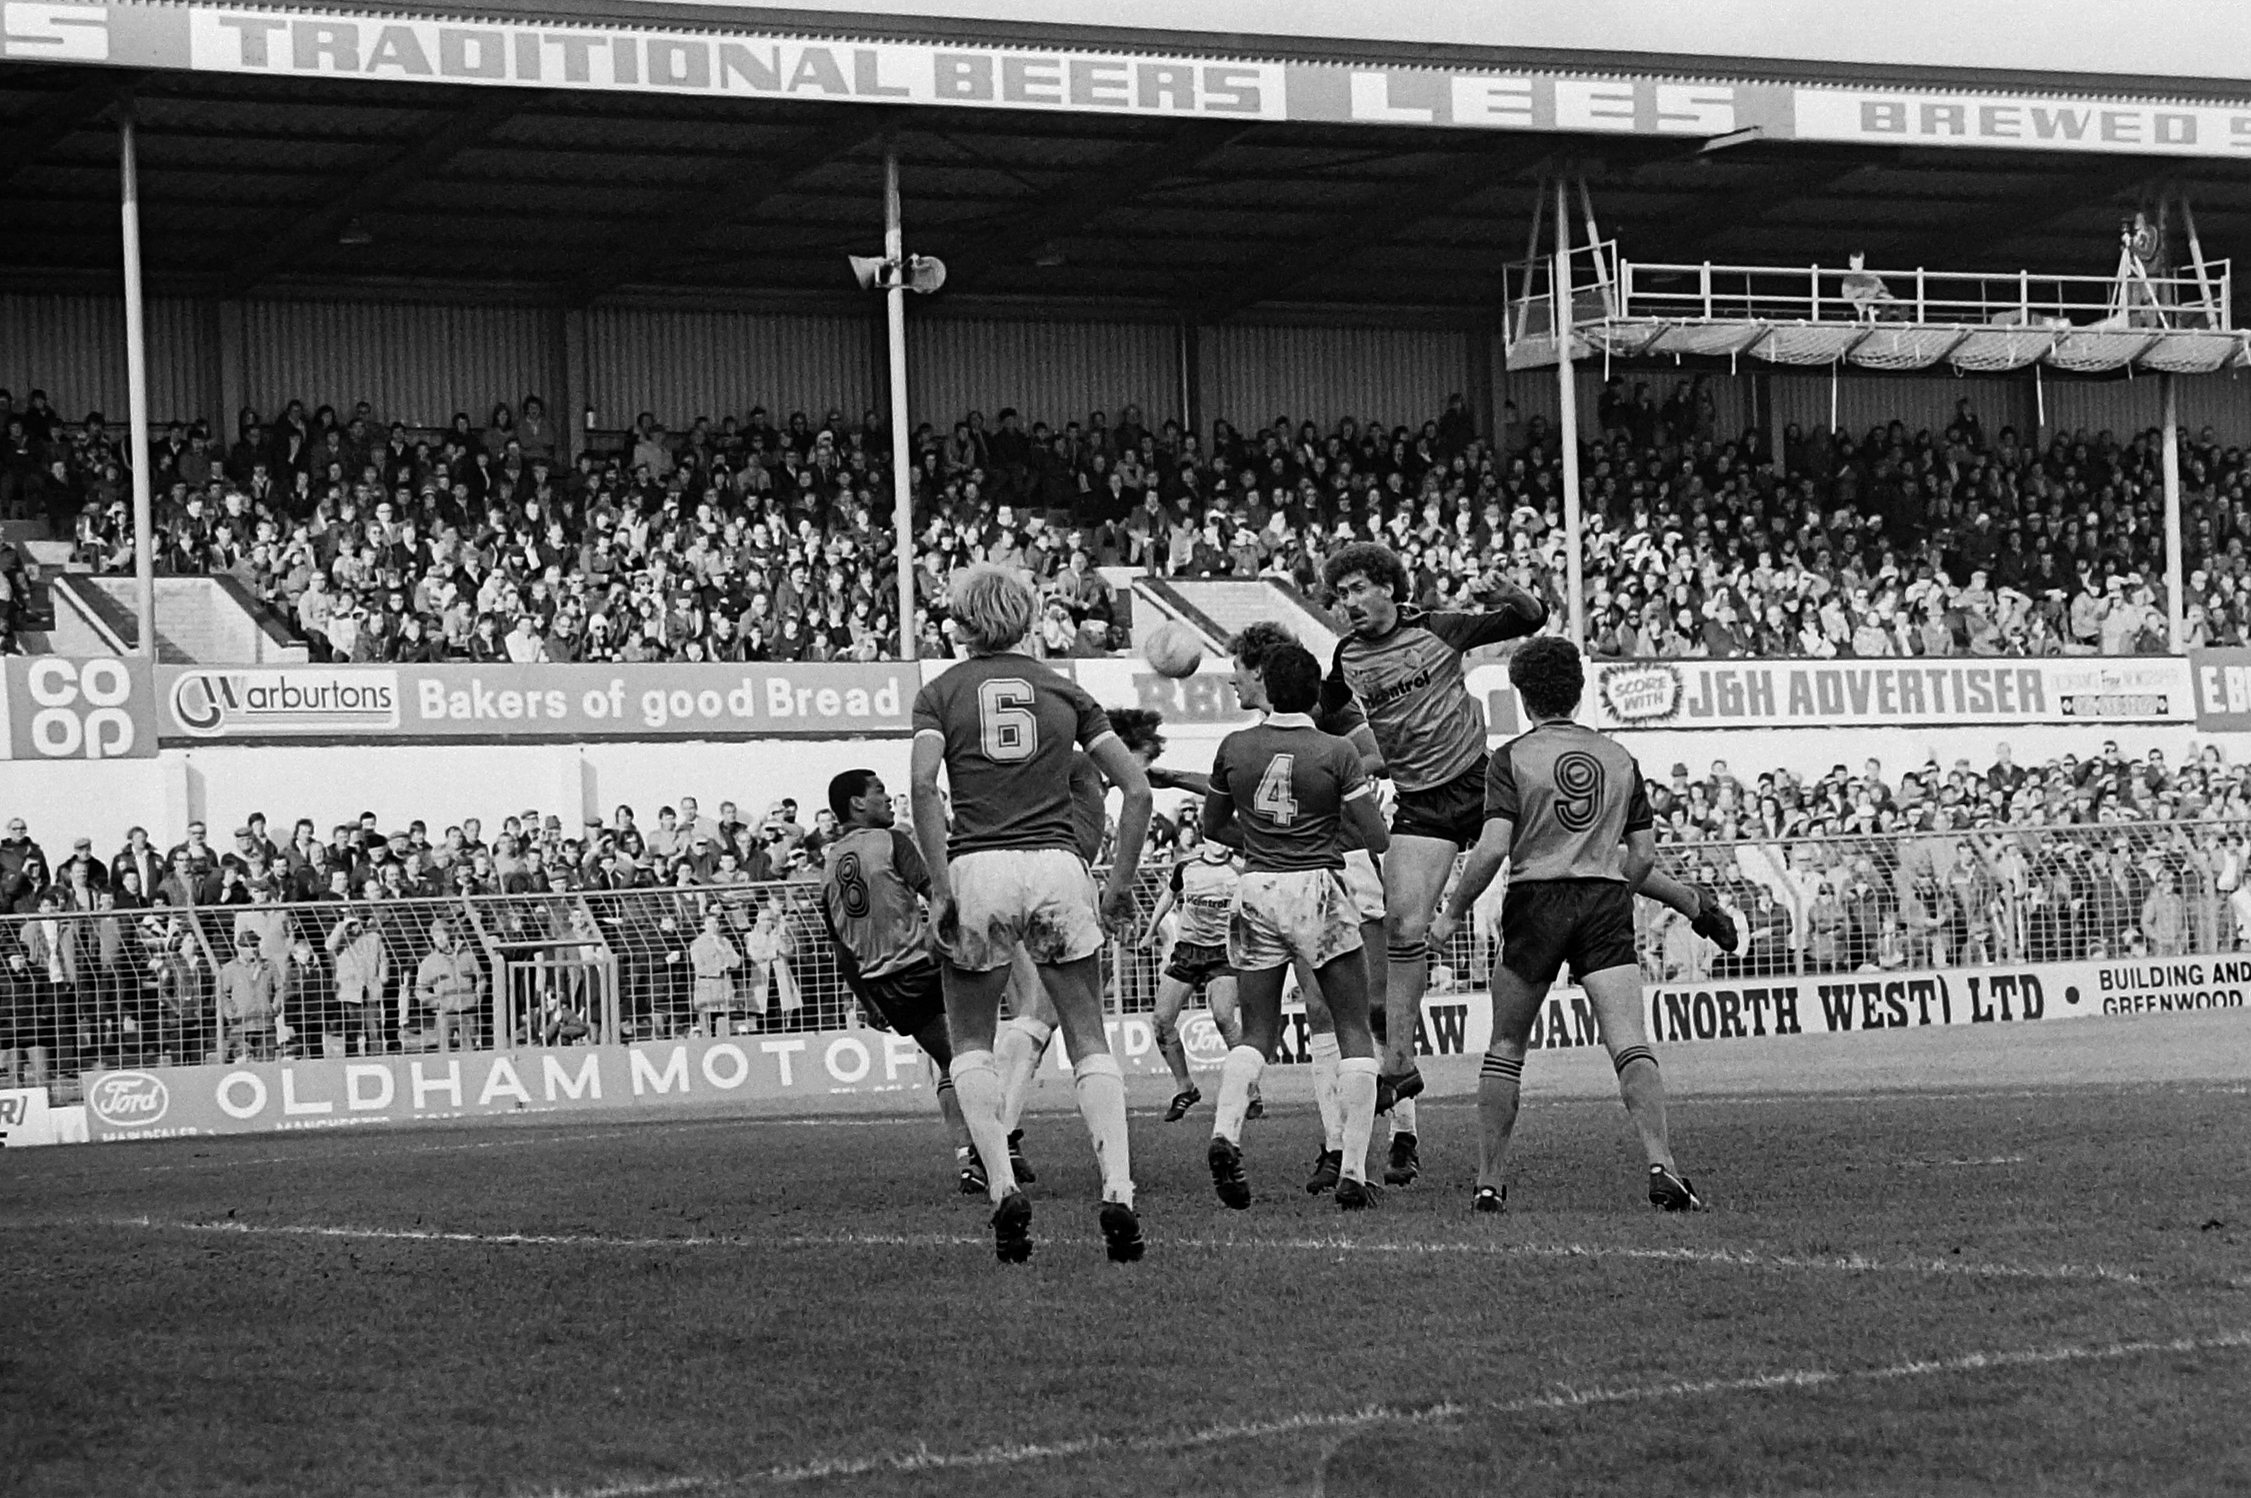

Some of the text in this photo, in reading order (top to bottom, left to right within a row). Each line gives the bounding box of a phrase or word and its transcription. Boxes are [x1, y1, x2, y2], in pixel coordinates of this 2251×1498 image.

[219, 15, 1262, 113] TRADITIONAL BEERS
[1350, 70, 1735, 134] LEES
[1859, 100, 2198, 145] BREWED
[176, 675, 392, 729] Warburtons
[417, 676, 900, 728] Bakers of good Bread
[1614, 675, 1667, 698] SCORE
[1624, 691, 1664, 711] WITH
[1687, 669, 1776, 718] J&H
[1789, 667, 2047, 716] ADVERTISER
[977, 678, 1037, 764] 6
[1252, 753, 1299, 828] 4
[1553, 750, 1605, 833] 9
[836, 851, 870, 919] 8
[2099, 961, 2251, 991] BUILDING AND
[2102, 990, 2243, 1015] GREENWOOD
[1652, 986, 1801, 1042] (NORTH
[1817, 974, 1952, 1032] WEST)
[1969, 973, 2044, 1022] LTD
[100, 1078, 161, 1115] Ford
[216, 1053, 602, 1119] OLDHAM
